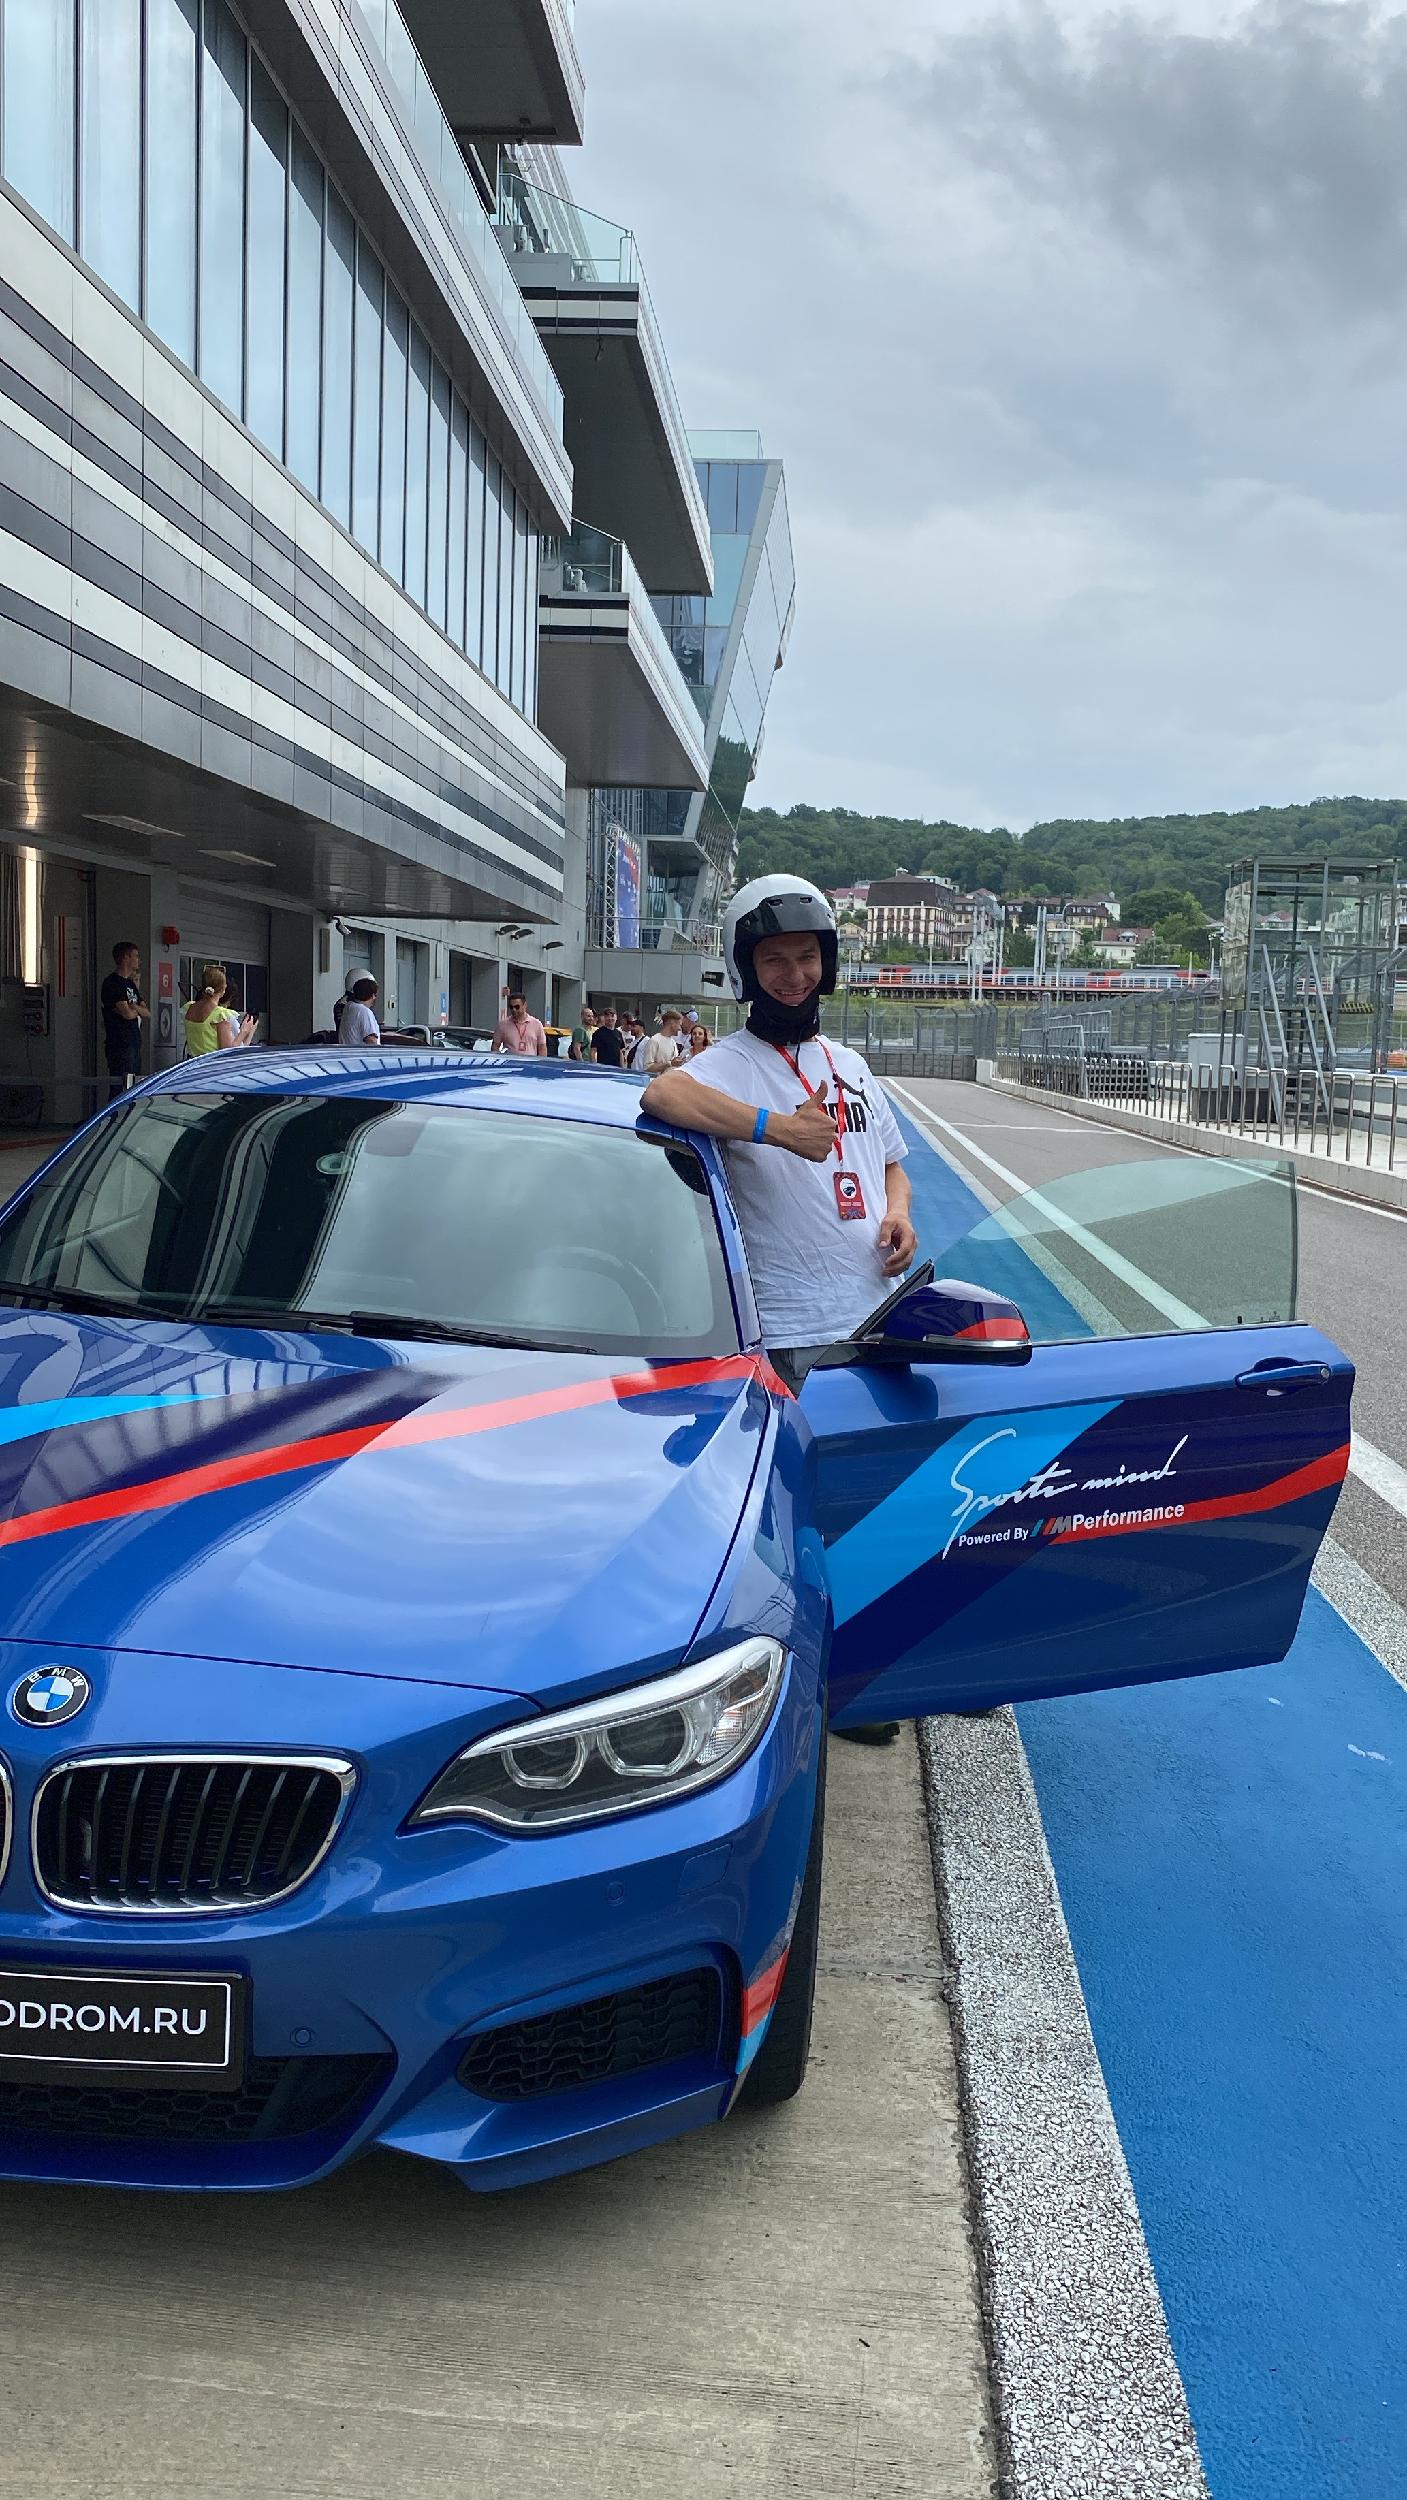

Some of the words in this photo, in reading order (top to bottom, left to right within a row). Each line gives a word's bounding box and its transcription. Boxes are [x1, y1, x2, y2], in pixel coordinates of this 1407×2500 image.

[162, 974, 169, 988] 6
[1081, 1434, 1189, 1490] mind
[958, 1527, 1011, 1547] Powered
[1014, 1525, 1029, 1541] By
[27, 1667, 85, 1687] BMW
[0, 1999, 207, 2035] ODROM.RU
